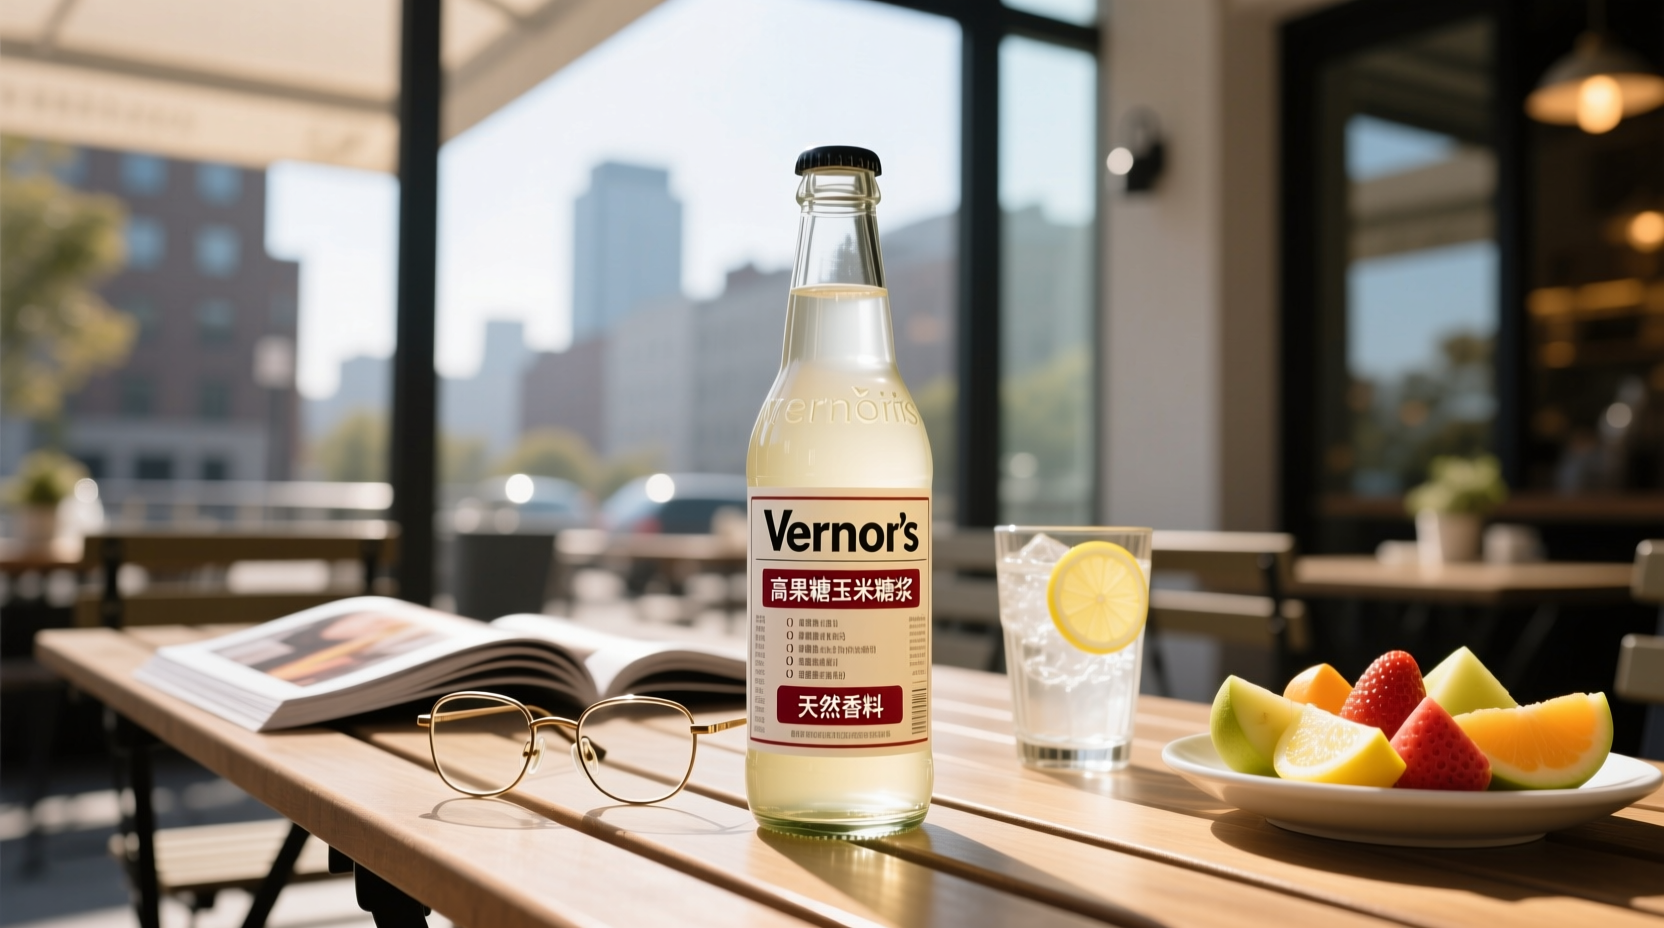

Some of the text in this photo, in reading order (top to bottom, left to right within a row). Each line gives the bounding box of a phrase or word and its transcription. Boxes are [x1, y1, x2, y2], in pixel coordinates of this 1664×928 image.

[763, 509, 919, 553] Vernor's
[770, 575, 913, 603] 高果糖玉米糖浆
[797, 692, 884, 720] 天然香料
